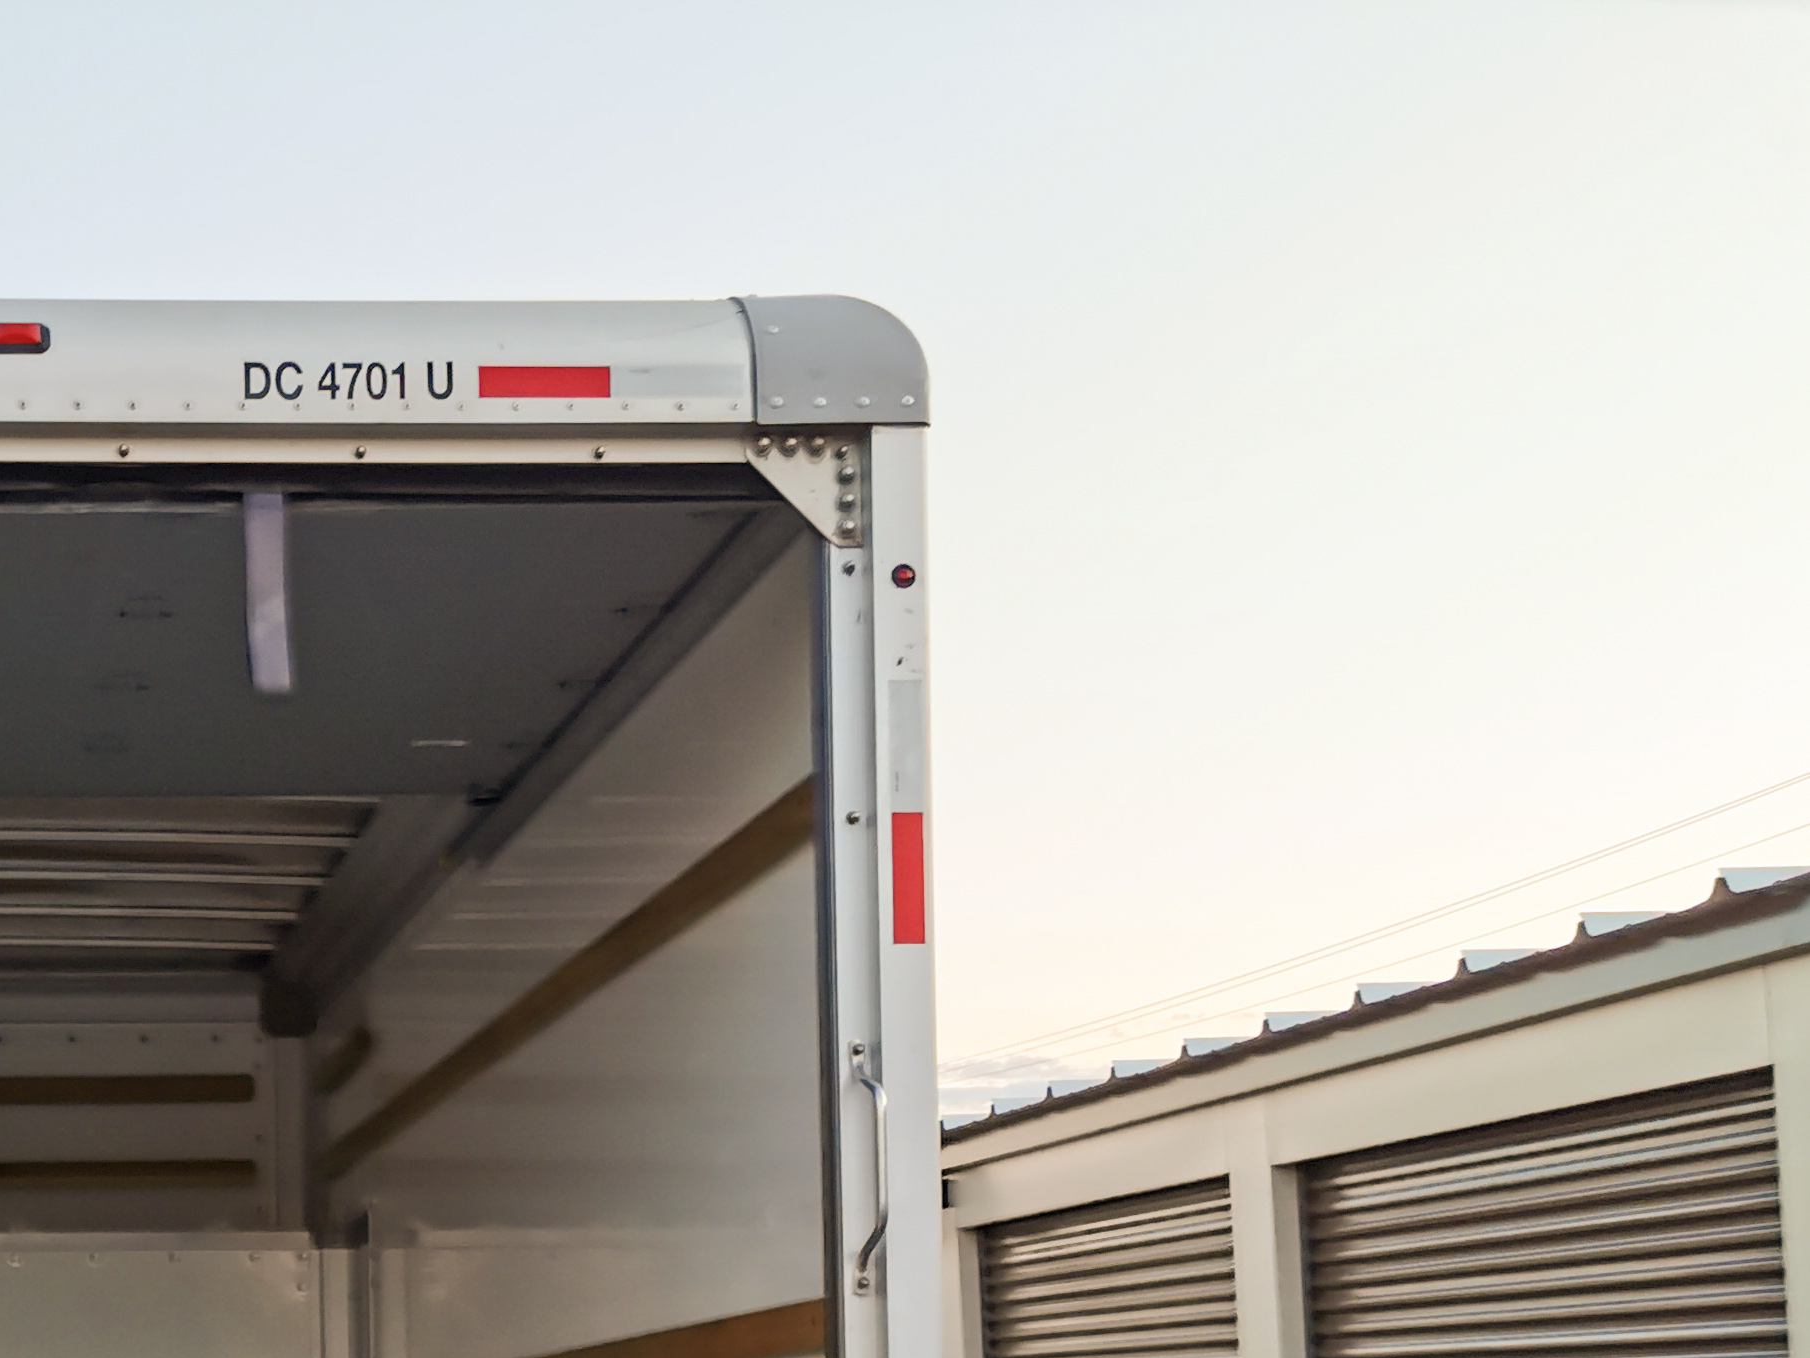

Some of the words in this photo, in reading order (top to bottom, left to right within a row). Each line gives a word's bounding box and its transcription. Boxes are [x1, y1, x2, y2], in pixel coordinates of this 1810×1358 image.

[243, 360, 304, 400] DC
[317, 360, 406, 400] 4701
[426, 360, 454, 400] U
